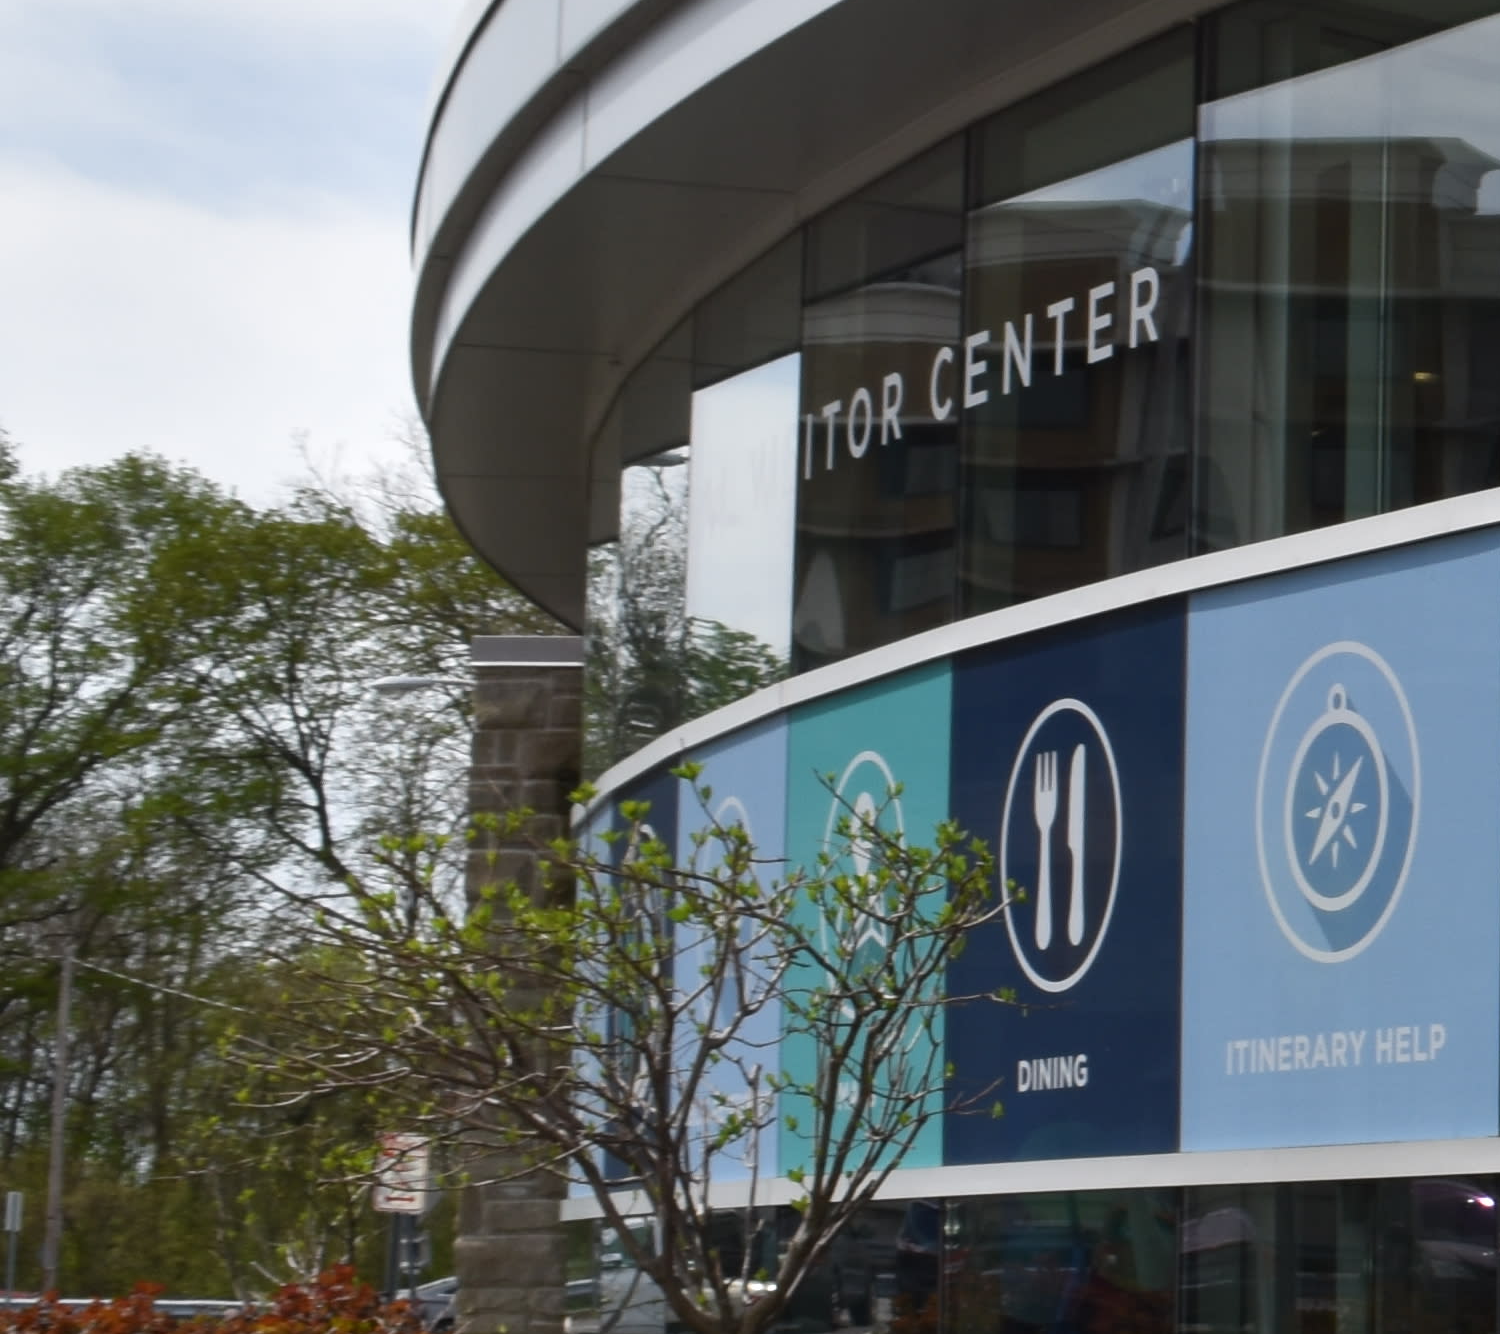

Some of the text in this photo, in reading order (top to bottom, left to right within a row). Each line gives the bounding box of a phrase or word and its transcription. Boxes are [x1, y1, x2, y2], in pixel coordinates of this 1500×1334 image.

[930, 267, 1159, 421] CENTER
[1017, 1054, 1088, 1092] DINING
[1226, 1023, 1447, 1075] ITINERARY HELP
